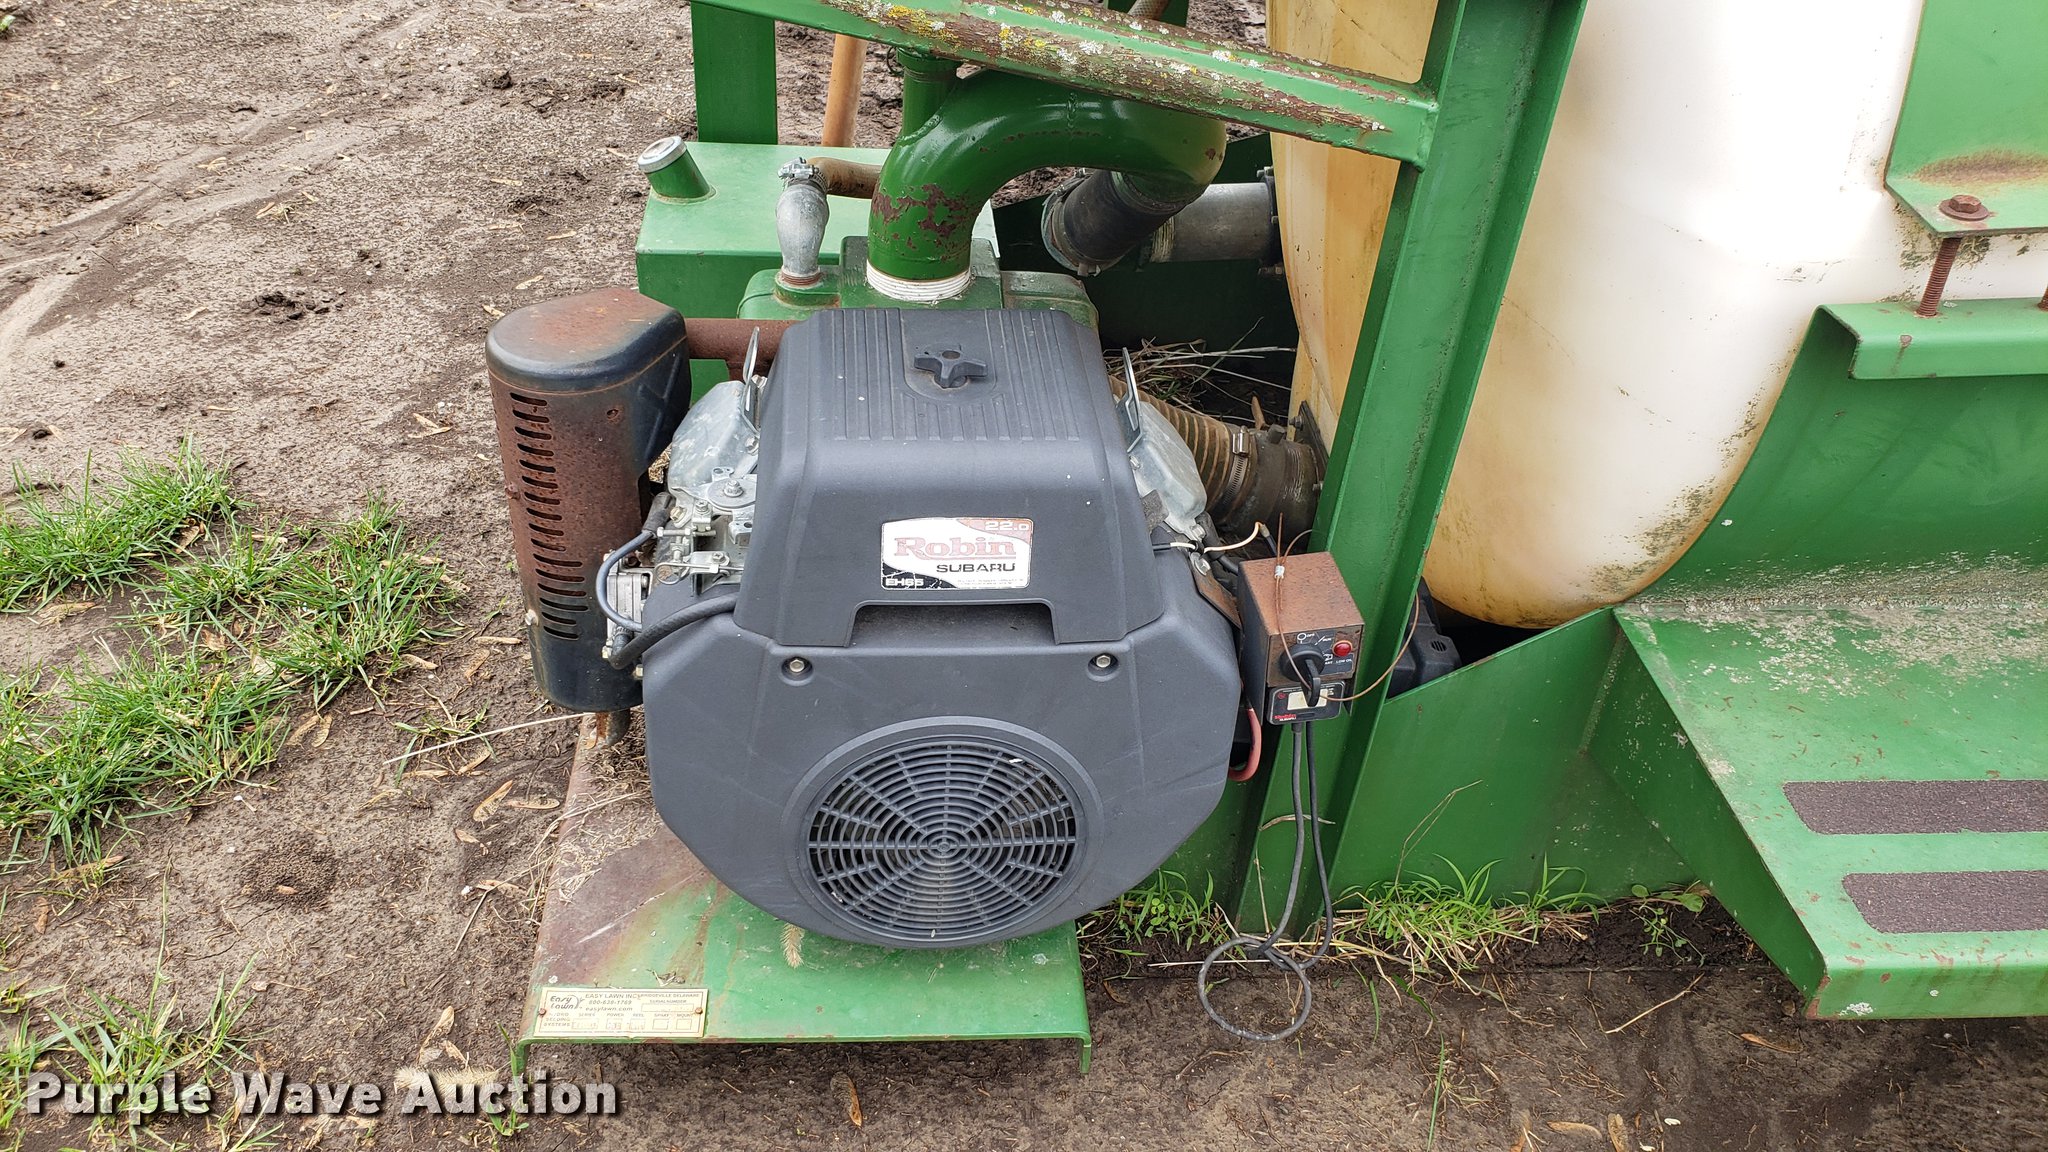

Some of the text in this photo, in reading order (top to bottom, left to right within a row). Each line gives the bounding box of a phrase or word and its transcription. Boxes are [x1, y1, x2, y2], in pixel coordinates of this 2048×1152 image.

[985, 521, 1030, 531] 22.0
[894, 536, 1017, 560] Robin
[936, 563, 1015, 573] SUBARU
[550, 995, 573, 1004] Easy
